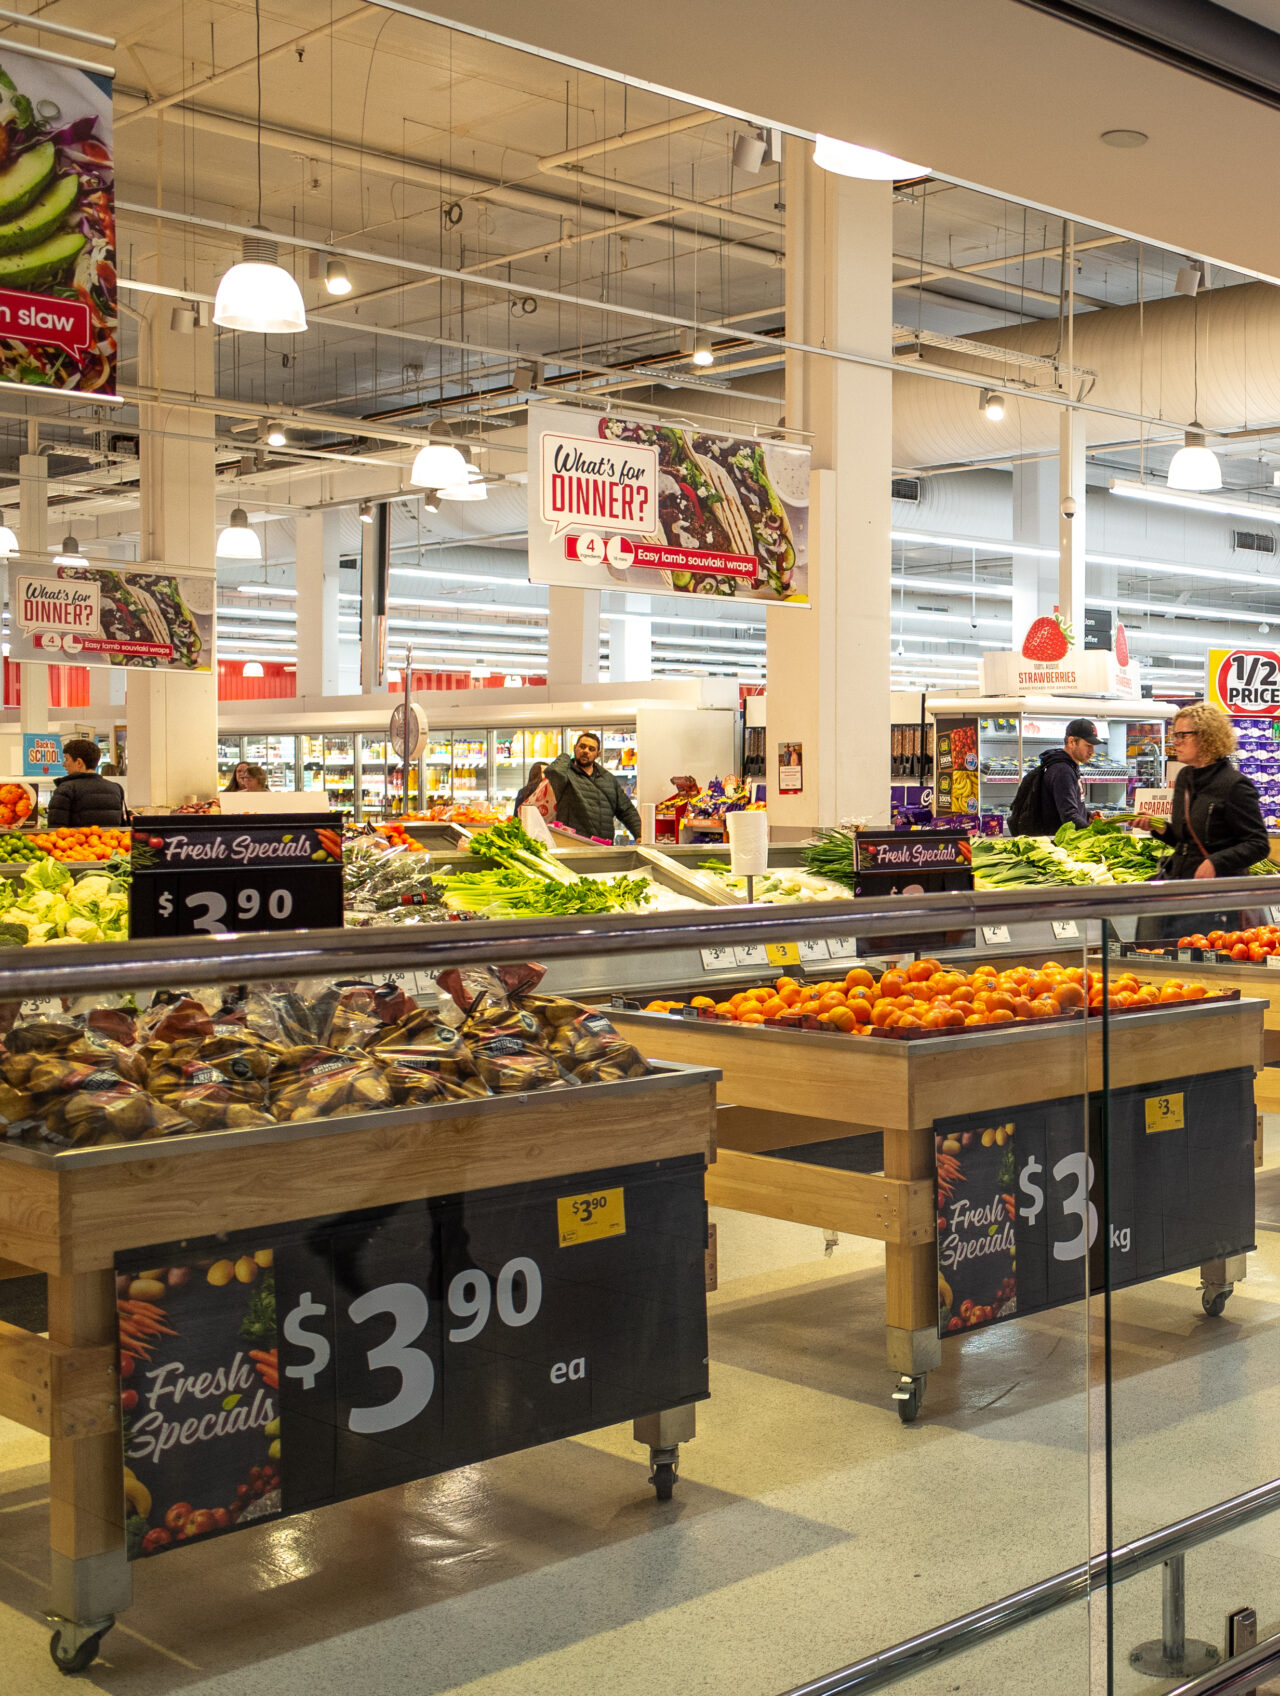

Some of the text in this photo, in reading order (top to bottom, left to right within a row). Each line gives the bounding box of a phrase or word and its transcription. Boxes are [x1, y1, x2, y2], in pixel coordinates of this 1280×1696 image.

[18, 306, 75, 332] slaw
[554, 443, 646, 486] What's for
[551, 473, 649, 522] DINNER?
[586, 538, 595, 553] 4
[637, 549, 753, 572] Easy lamb souvlaki wraps
[25, 582, 92, 606] What's for
[24, 599, 93, 626] DINNER?
[47, 635, 55, 645] 4
[84, 641, 101, 650] Easy
[102, 642, 120, 651] lamb
[121, 644, 149, 652] souvlaki
[149, 646, 170, 655] wraps
[1084, 635, 1098, 643] offee
[1018, 671, 1077, 684] STRAWBERRIES
[1231, 654, 1279, 688] 1/2
[1228, 687, 1280, 704] PRICE
[29, 749, 61, 763] SCHOOL
[35, 739, 56, 749] Back to
[165, 834, 312, 865] Fresh Specials
[877, 843, 956, 866] Fresh Specials
[775, 945, 788, 957] $3
[1157, 1098, 1170, 1116] $3
[571, 1195, 608, 1223] $390
[949, 1194, 1005, 1234] Fresh
[1018, 1151, 1099, 1262] $3
[939, 1220, 1016, 1272] Specials
[1109, 1223, 1132, 1253] kg
[144, 1352, 254, 1413] Fresh
[549, 1355, 587, 1385] ea
[127, 1396, 281, 1465] Specials
